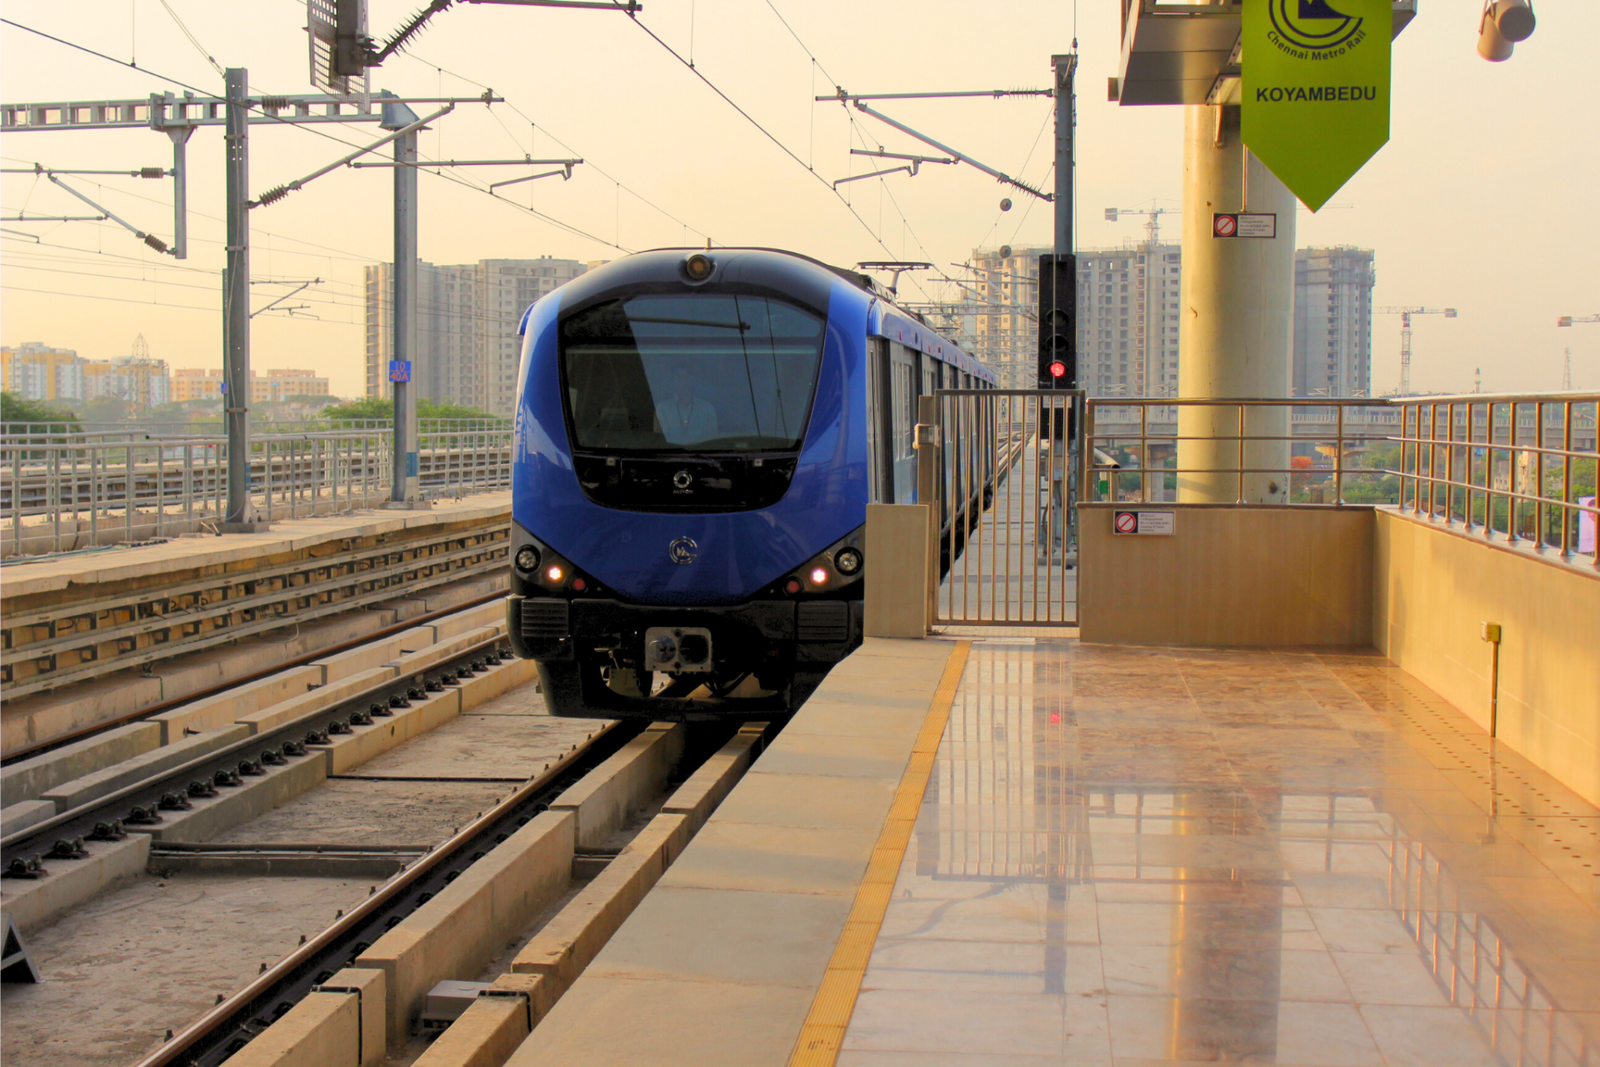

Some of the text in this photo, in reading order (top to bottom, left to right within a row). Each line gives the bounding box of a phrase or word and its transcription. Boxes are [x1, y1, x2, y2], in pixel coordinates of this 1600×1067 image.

[1267, 29, 1367, 60] Chennai Metro Rail
[1256, 86, 1376, 102] KOYAMBEDU
[390, 371, 410, 382] 40A
